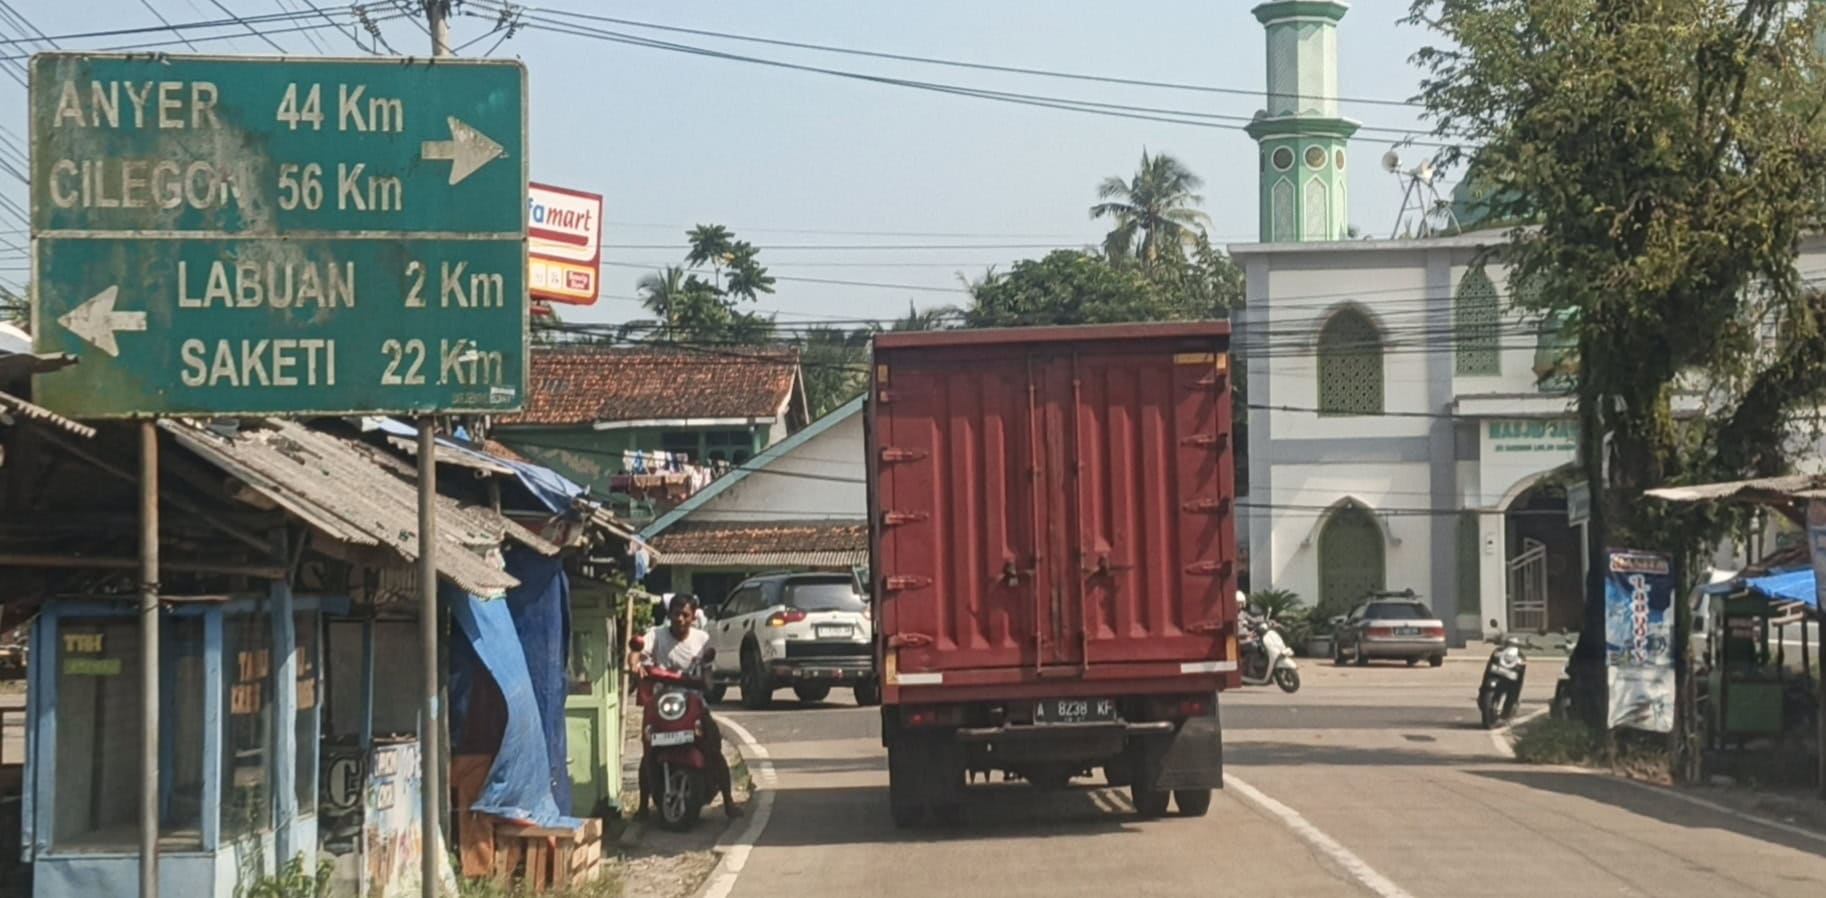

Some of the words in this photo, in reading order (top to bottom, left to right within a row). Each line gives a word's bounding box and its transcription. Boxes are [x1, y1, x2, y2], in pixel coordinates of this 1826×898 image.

[53, 80, 220, 128] ANYER
[277, 83, 324, 130] 44
[339, 84, 403, 132] Km
[49, 159, 248, 208] CILEGON
[278, 163, 323, 210] 56
[338, 163, 402, 211] Km
[178, 261, 355, 308] LABUAN
[404, 261, 426, 308] 2
[441, 261, 503, 308] Km
[181, 338, 335, 387] SAKETI
[381, 339, 425, 385] 22
[441, 339, 502, 385] Km
[1037, 703, 1044, 717] A
